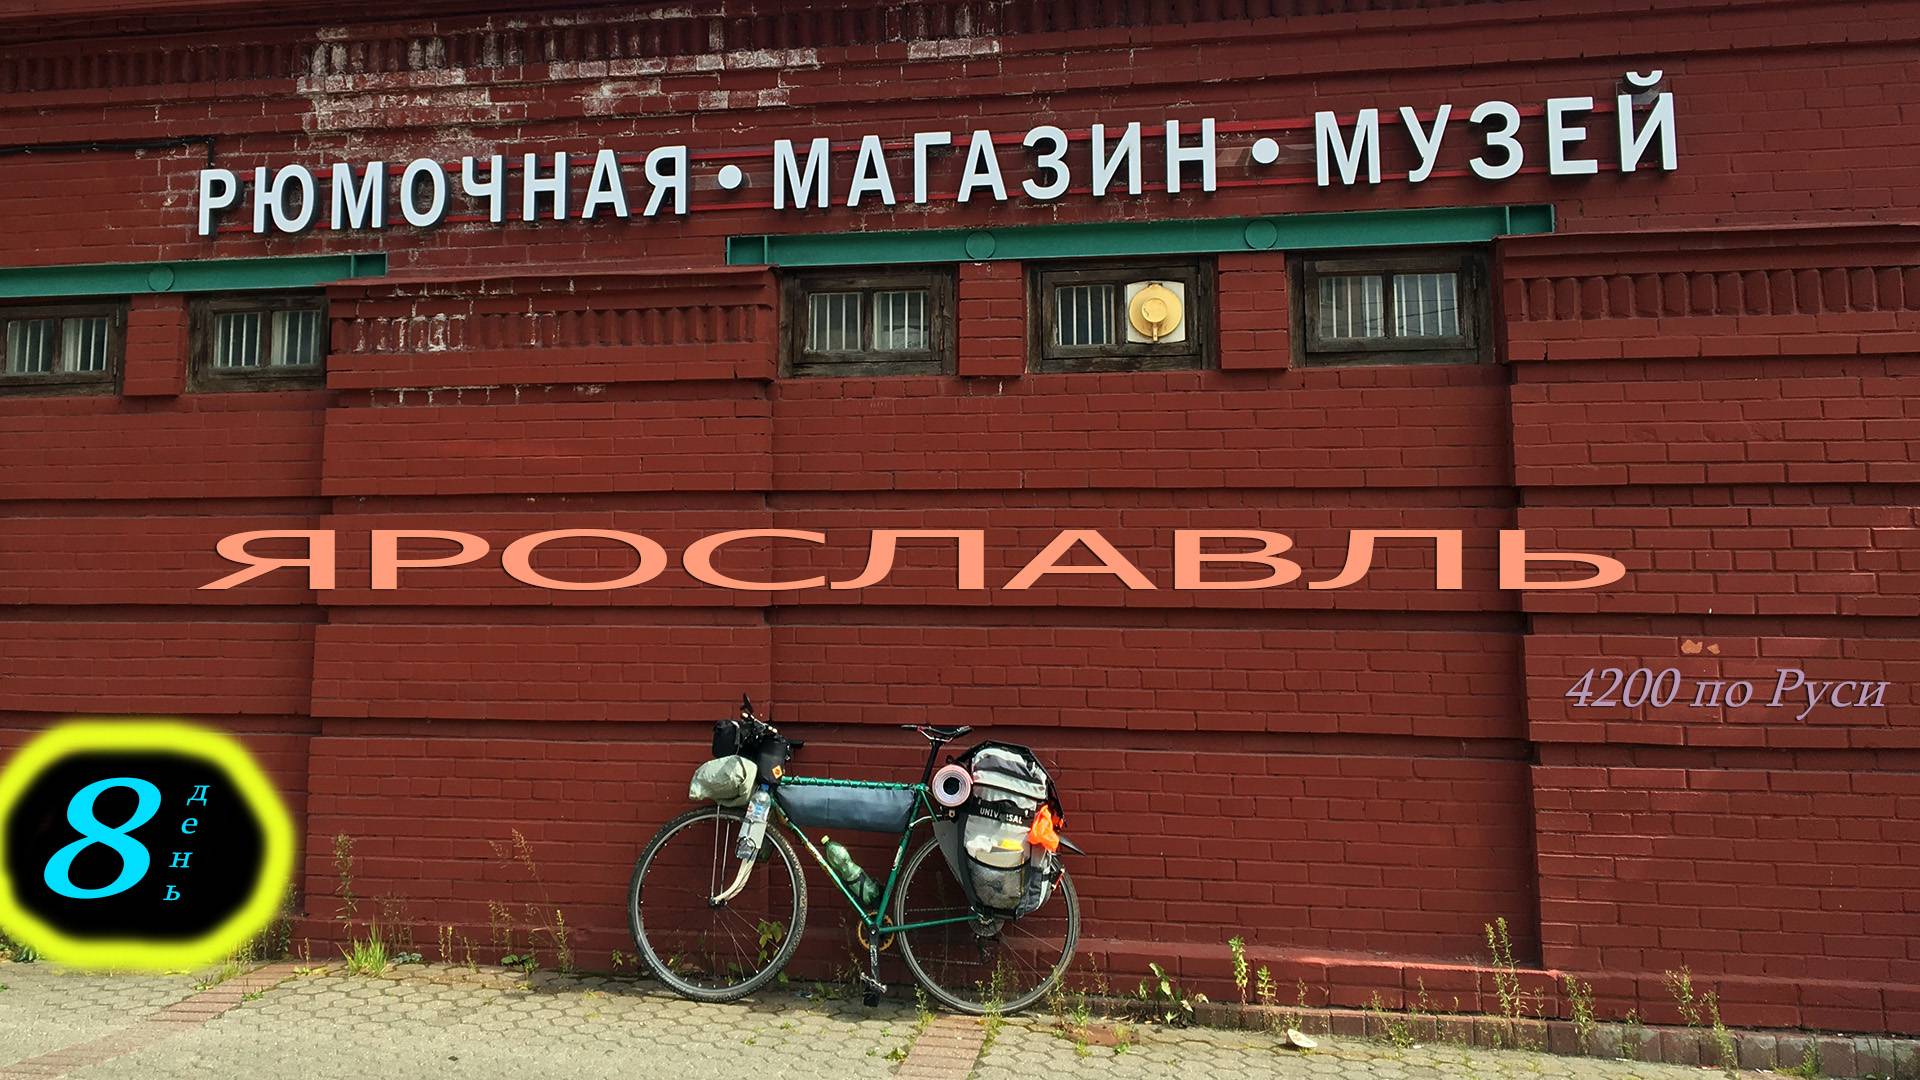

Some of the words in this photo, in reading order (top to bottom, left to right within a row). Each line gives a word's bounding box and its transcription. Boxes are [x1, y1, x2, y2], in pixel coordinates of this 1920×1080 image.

[198, 145, 688, 236] РЮМОЧНАЯ
[773, 117, 1218, 210] МАГАЗИН
[1314, 70, 1679, 187] МУЗЕЙ
[979, 807, 1024, 825] UNIVSAL
